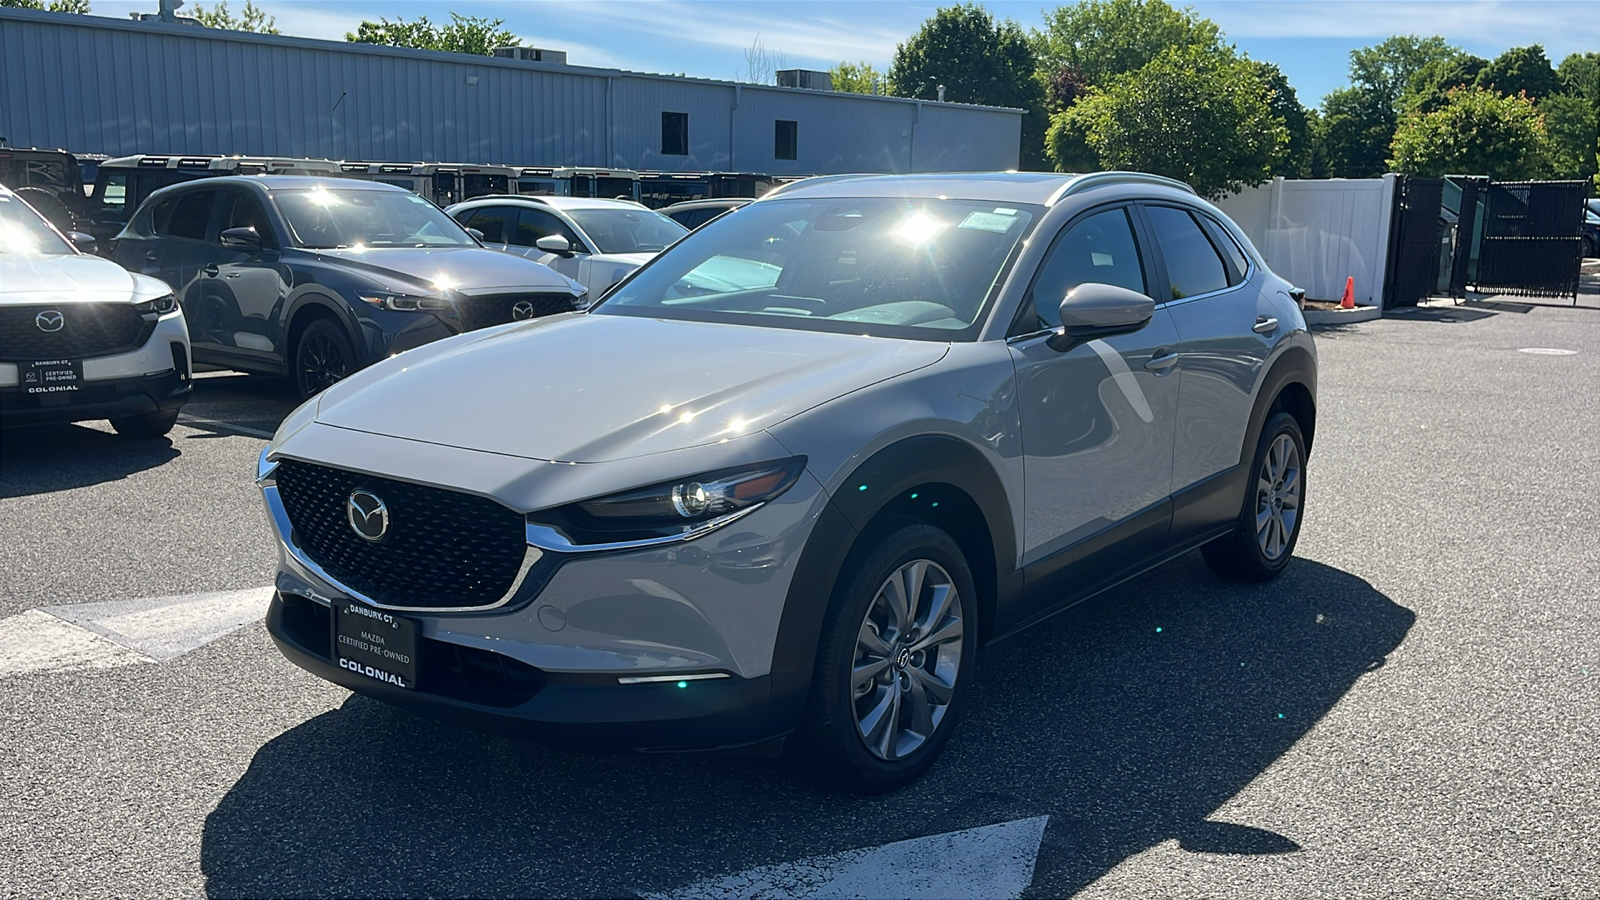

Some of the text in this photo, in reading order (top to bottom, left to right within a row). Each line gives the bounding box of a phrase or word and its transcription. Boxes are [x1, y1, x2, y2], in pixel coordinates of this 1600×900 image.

[28, 385, 79, 393] COLONIAL
[383, 614, 393, 623] CT
[361, 631, 385, 645] MAZDA
[338, 635, 410, 664] CERTIFIED PRE-OWNED
[339, 658, 405, 687] COLONIAL
